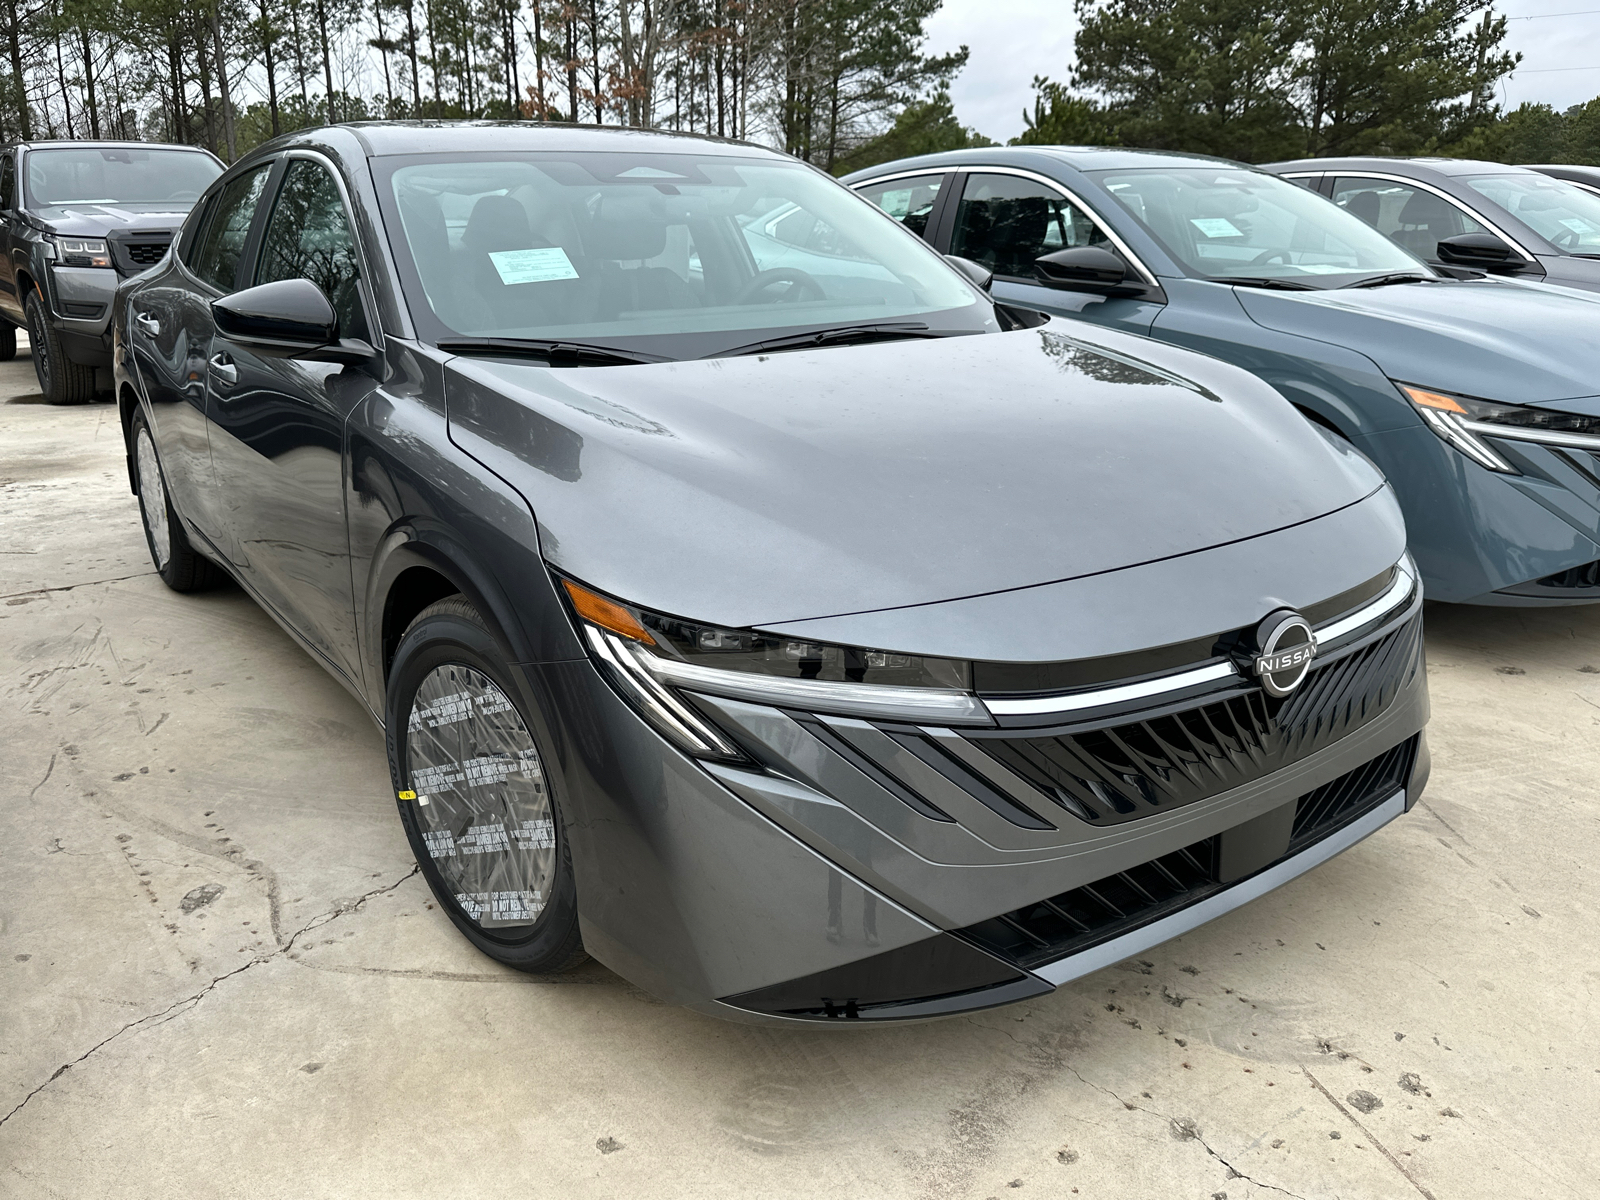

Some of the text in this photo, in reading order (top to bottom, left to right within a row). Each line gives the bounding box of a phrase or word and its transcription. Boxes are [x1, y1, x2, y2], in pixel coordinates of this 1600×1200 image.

[1260, 644, 1317, 672] NISSAN
[470, 757, 489, 767] CUSTOMER
[471, 766, 482, 779] NOT
[480, 763, 500, 777] REMOVE
[476, 776, 495, 786] CUSTOMER
[389, 754, 412, 836] KINRGY
[491, 891, 500, 900] FOR
[499, 891, 519, 901] CUSTOMER
[491, 900, 500, 912] DO
[498, 900, 511, 912] NOT
[500, 910, 521, 920] CUSTOMER
